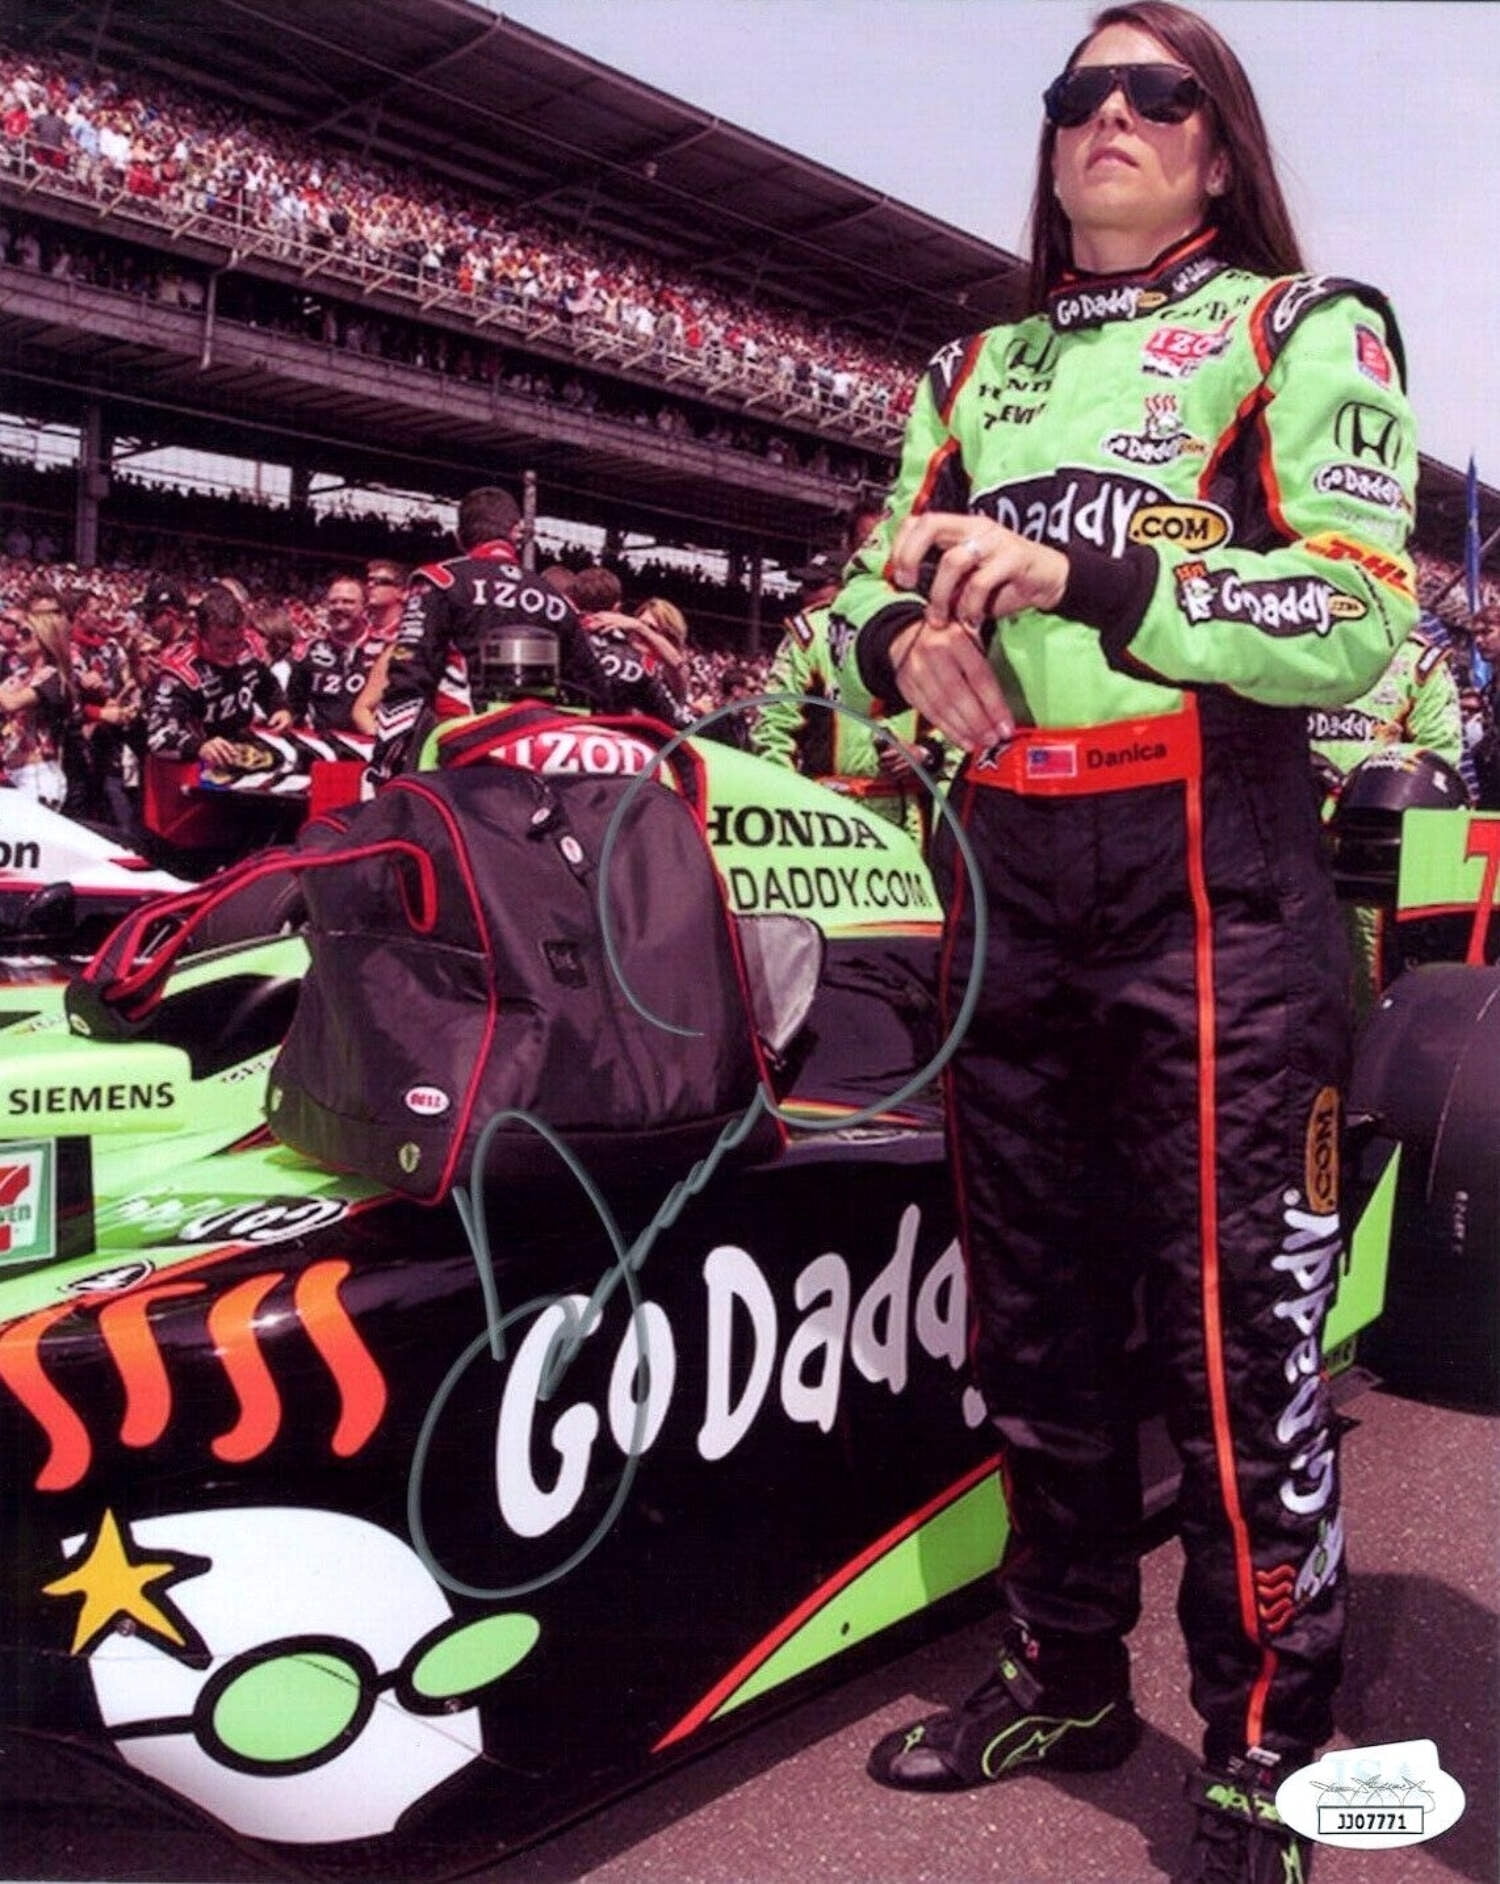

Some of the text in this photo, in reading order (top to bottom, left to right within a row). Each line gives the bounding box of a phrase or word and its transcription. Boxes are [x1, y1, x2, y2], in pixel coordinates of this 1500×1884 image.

[472, 578, 567, 622] IZOD
[312, 673, 365, 694] IZO
[204, 686, 253, 723] IZO
[515, 731, 656, 775] IZOD
[1086, 741, 1167, 769] Danica
[707, 804, 888, 850] HONDA
[8, 1081, 175, 1116] SIEMENS
